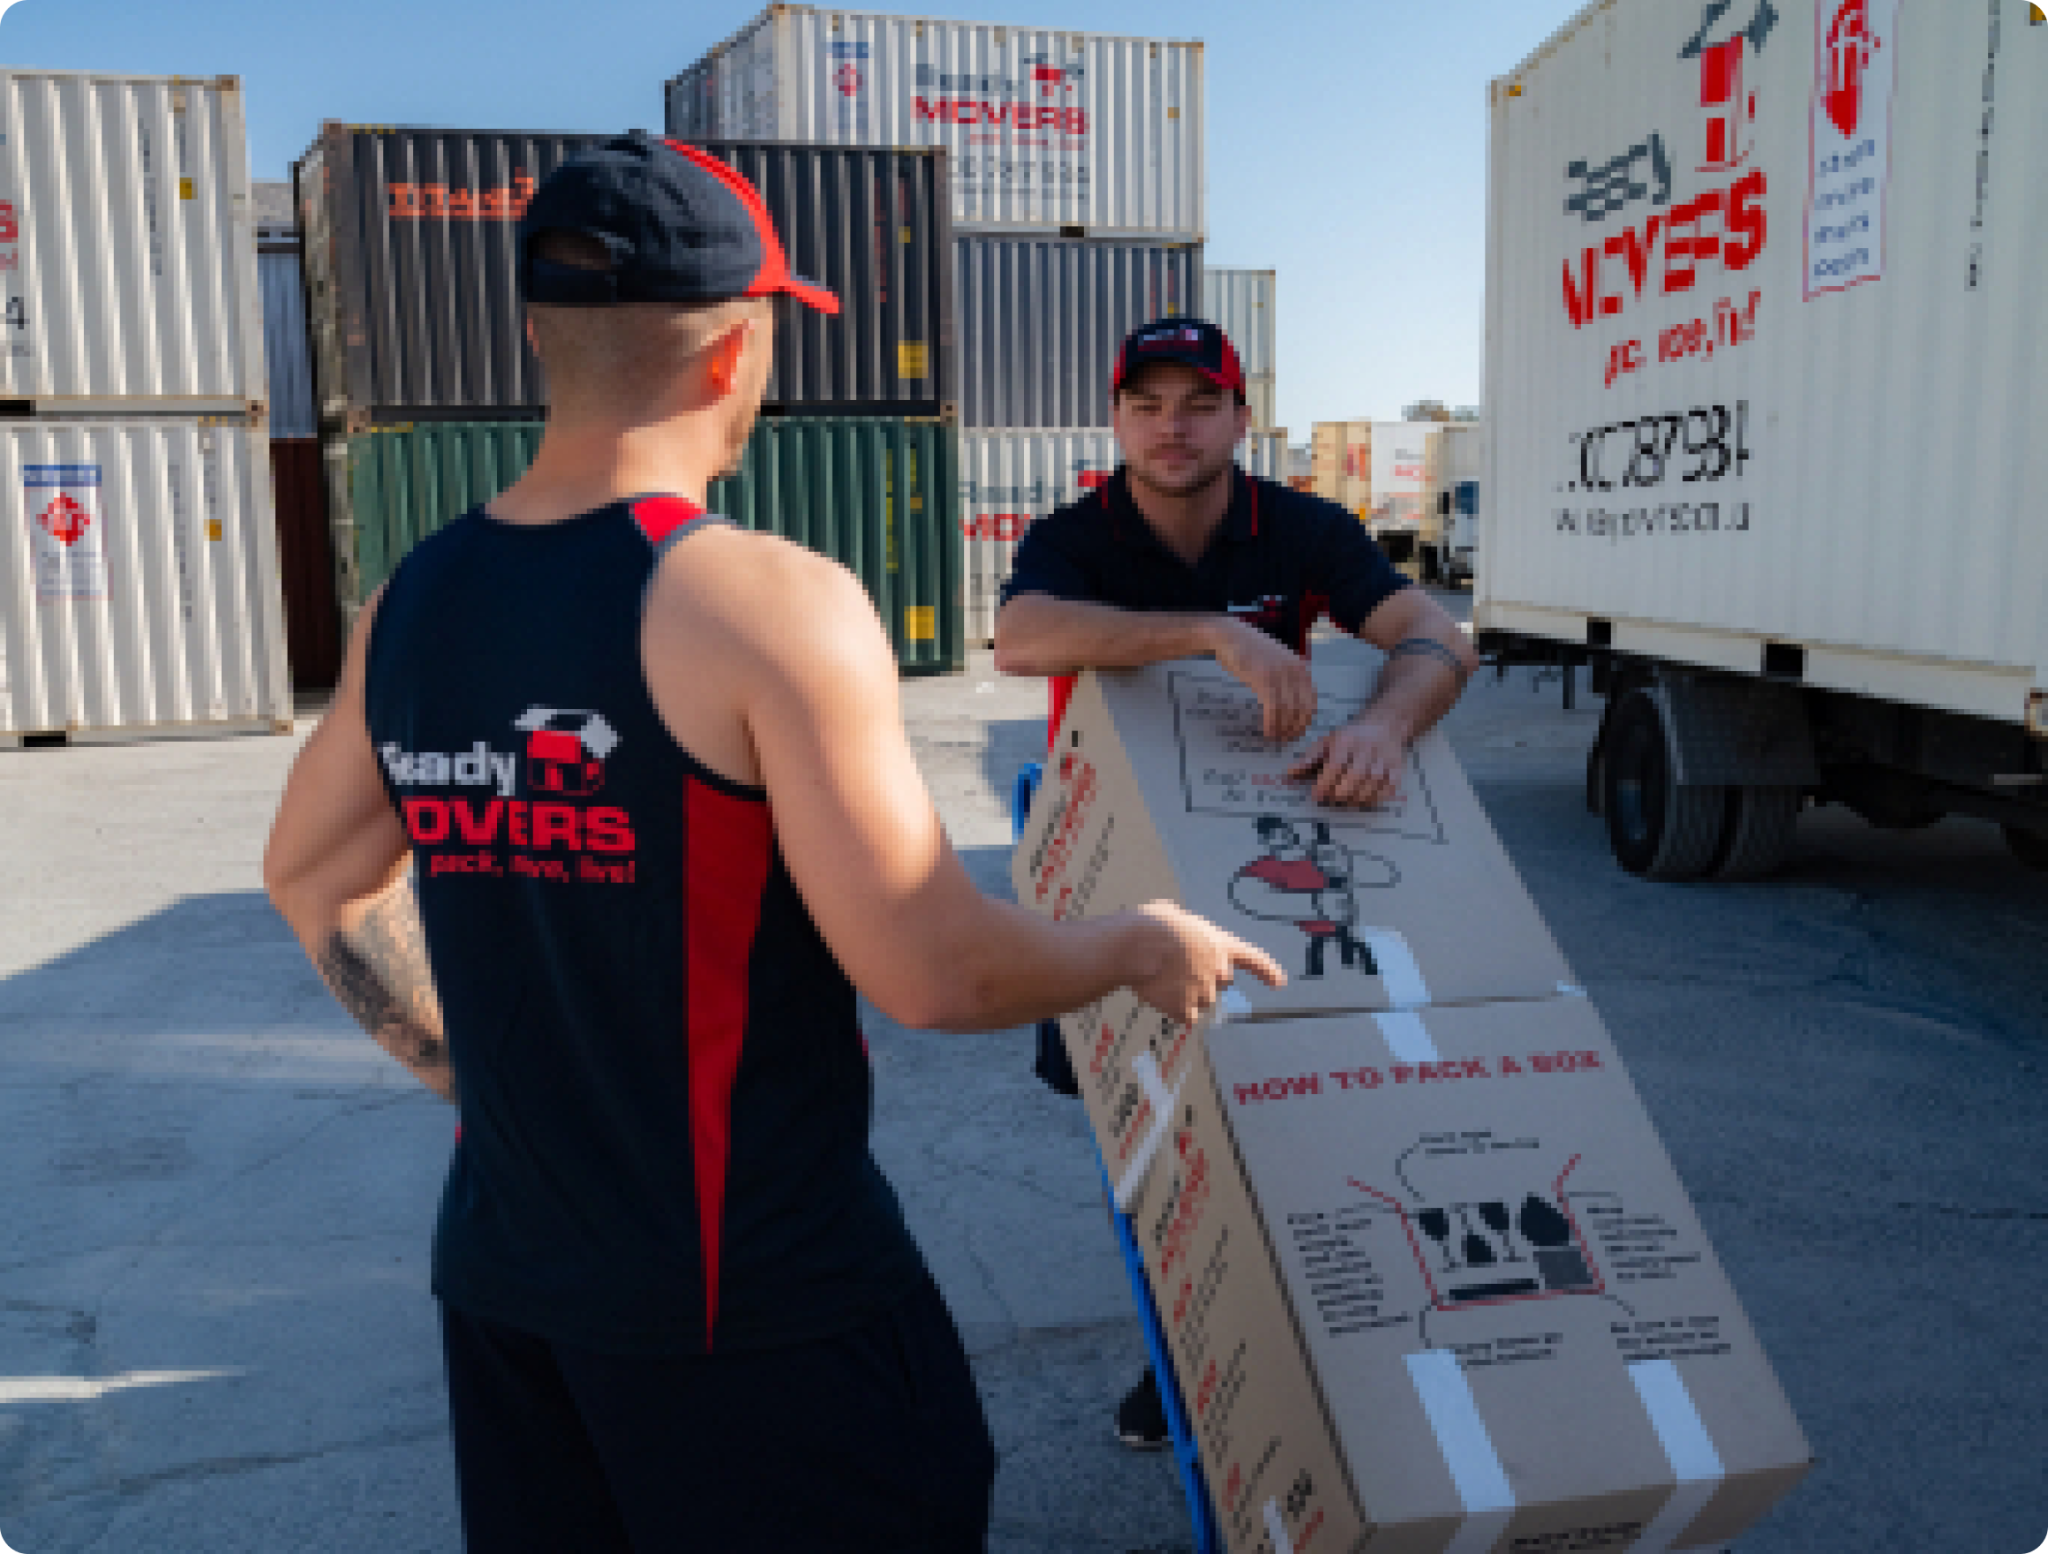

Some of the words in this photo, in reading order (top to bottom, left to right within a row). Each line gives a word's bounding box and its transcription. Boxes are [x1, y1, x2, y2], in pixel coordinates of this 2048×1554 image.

[401, 796, 637, 855] OVERS
[1233, 1073, 1323, 1105] HOW
[1329, 1067, 1383, 1089] TO
[1390, 1056, 1491, 1083] PACK
[1498, 1056, 1524, 1078] A
[1527, 1050, 1605, 1073] BOX
